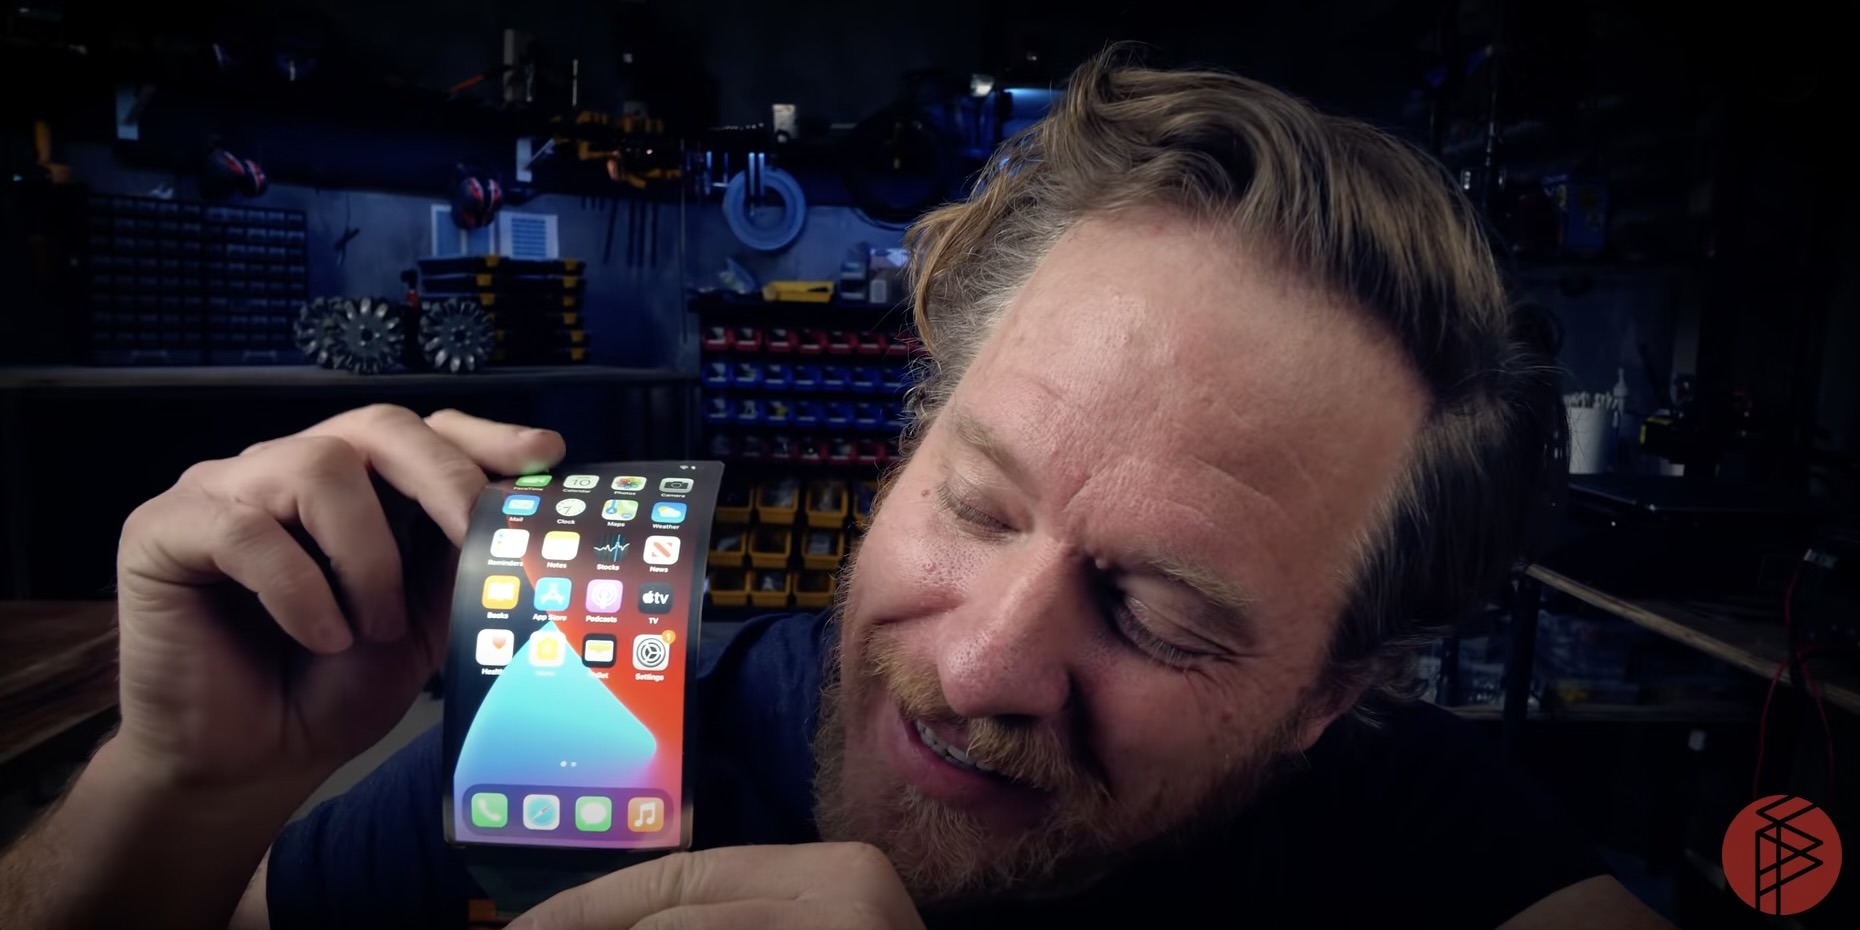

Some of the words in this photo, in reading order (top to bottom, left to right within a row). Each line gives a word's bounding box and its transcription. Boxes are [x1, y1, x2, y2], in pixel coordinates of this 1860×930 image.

[532, 614, 547, 622] App
[585, 615, 617, 623] Podcasts
[635, 673, 664, 682] Settings
